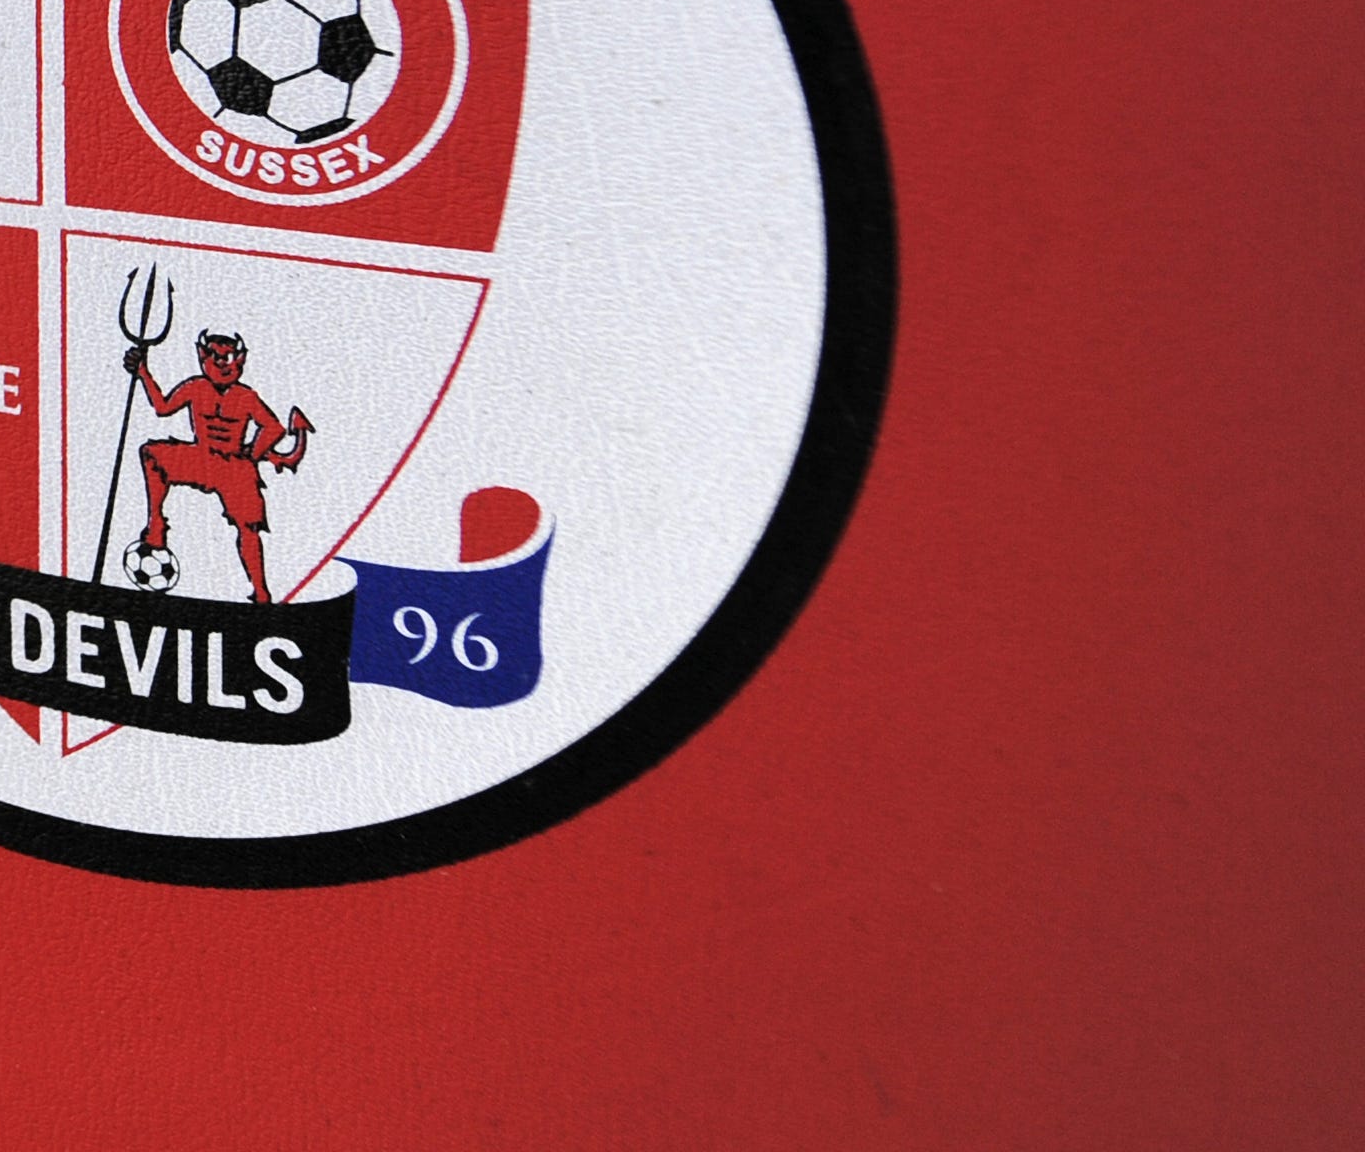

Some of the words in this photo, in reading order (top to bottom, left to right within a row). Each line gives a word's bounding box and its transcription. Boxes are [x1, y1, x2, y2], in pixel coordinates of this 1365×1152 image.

[196, 127, 385, 189] SUSSEX
[10, 596, 305, 715] DEVILS
[392, 604, 499, 672] 96
